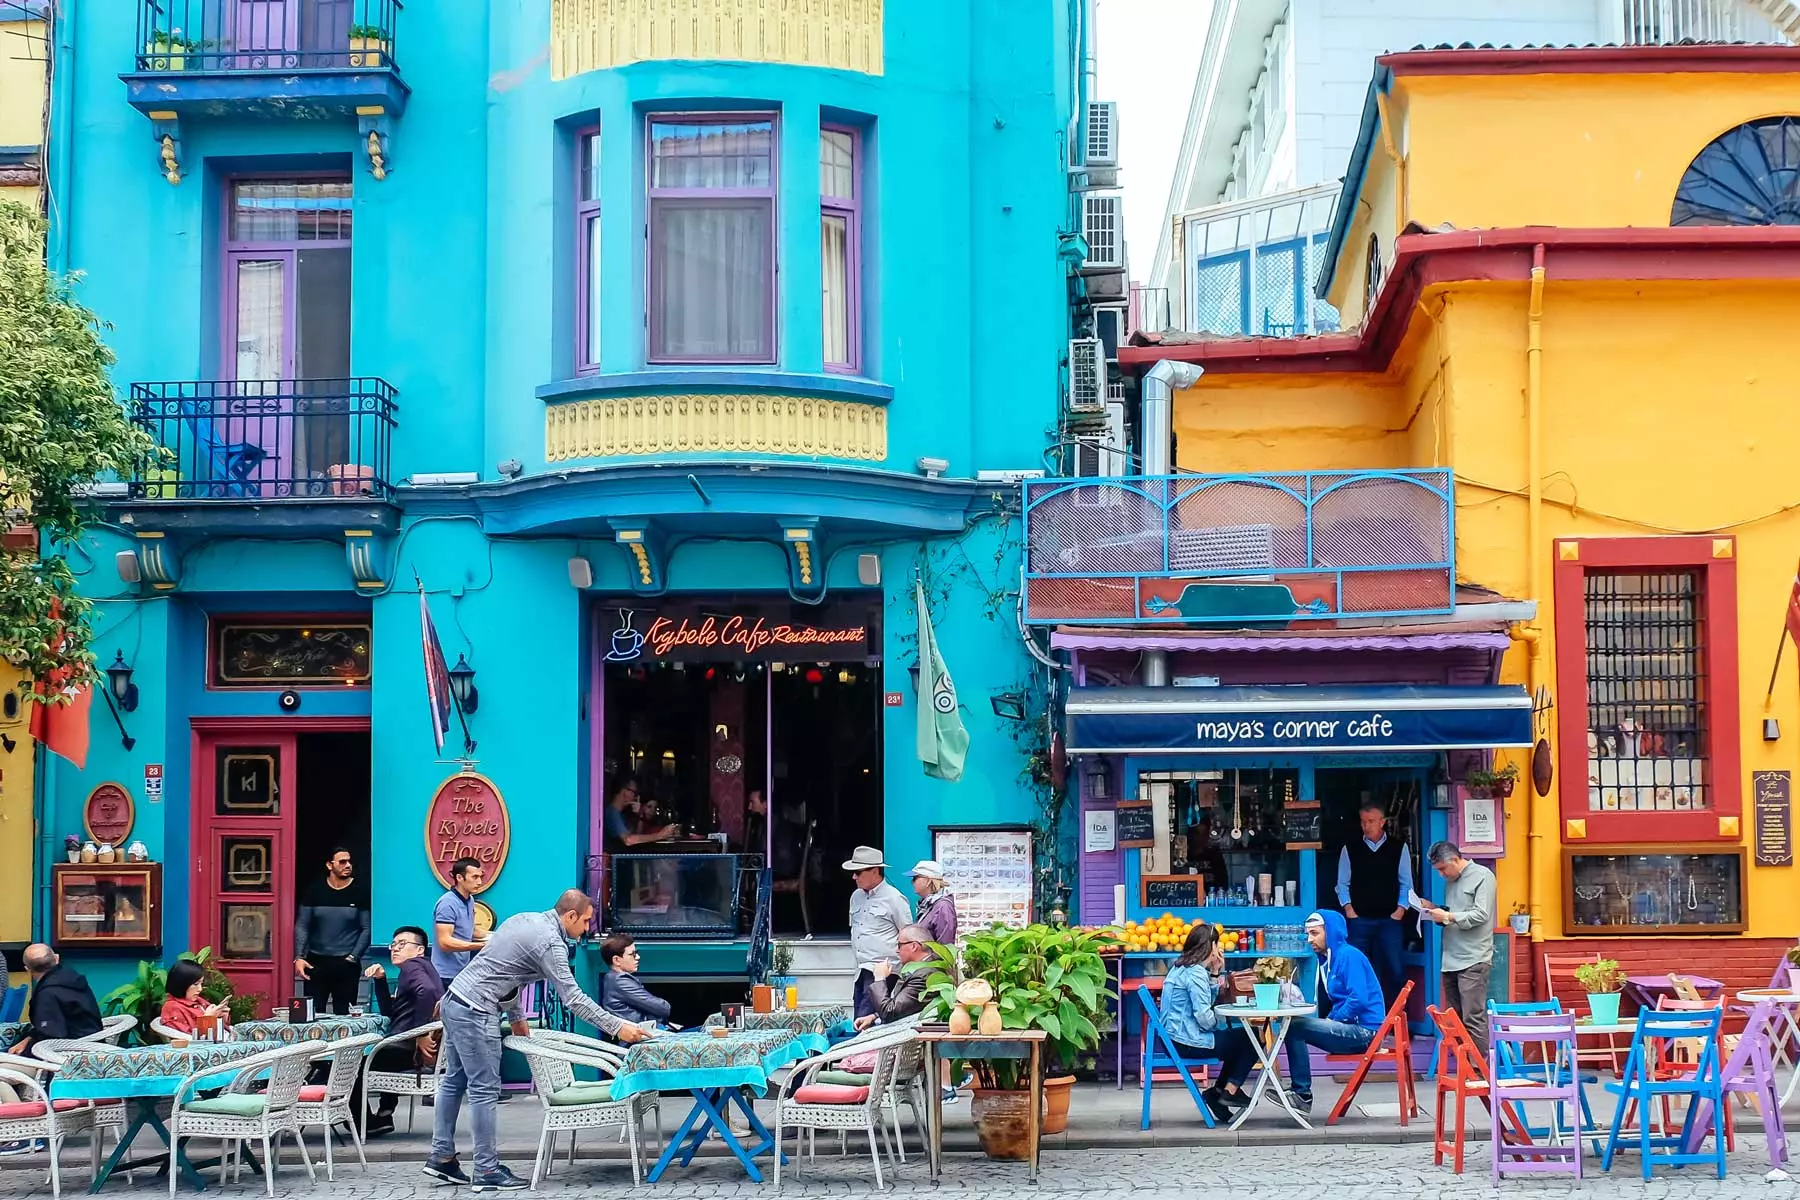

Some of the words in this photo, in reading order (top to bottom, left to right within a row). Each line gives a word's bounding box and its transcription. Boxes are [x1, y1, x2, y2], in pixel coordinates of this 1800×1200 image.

[644, 616, 718, 655] Kybele
[721, 616, 771, 653] Cafe
[771, 625, 865, 645] Restaurant
[1197, 719, 1265, 742] maya's
[1273, 720, 1340, 739] corner
[1347, 713, 1393, 738] cafe
[148, 767, 159, 776] 23
[452, 797, 485, 814] The
[438, 819, 499, 840] Kybele
[436, 840, 503, 862] Hotel
[293, 1000, 300, 1009] 2
